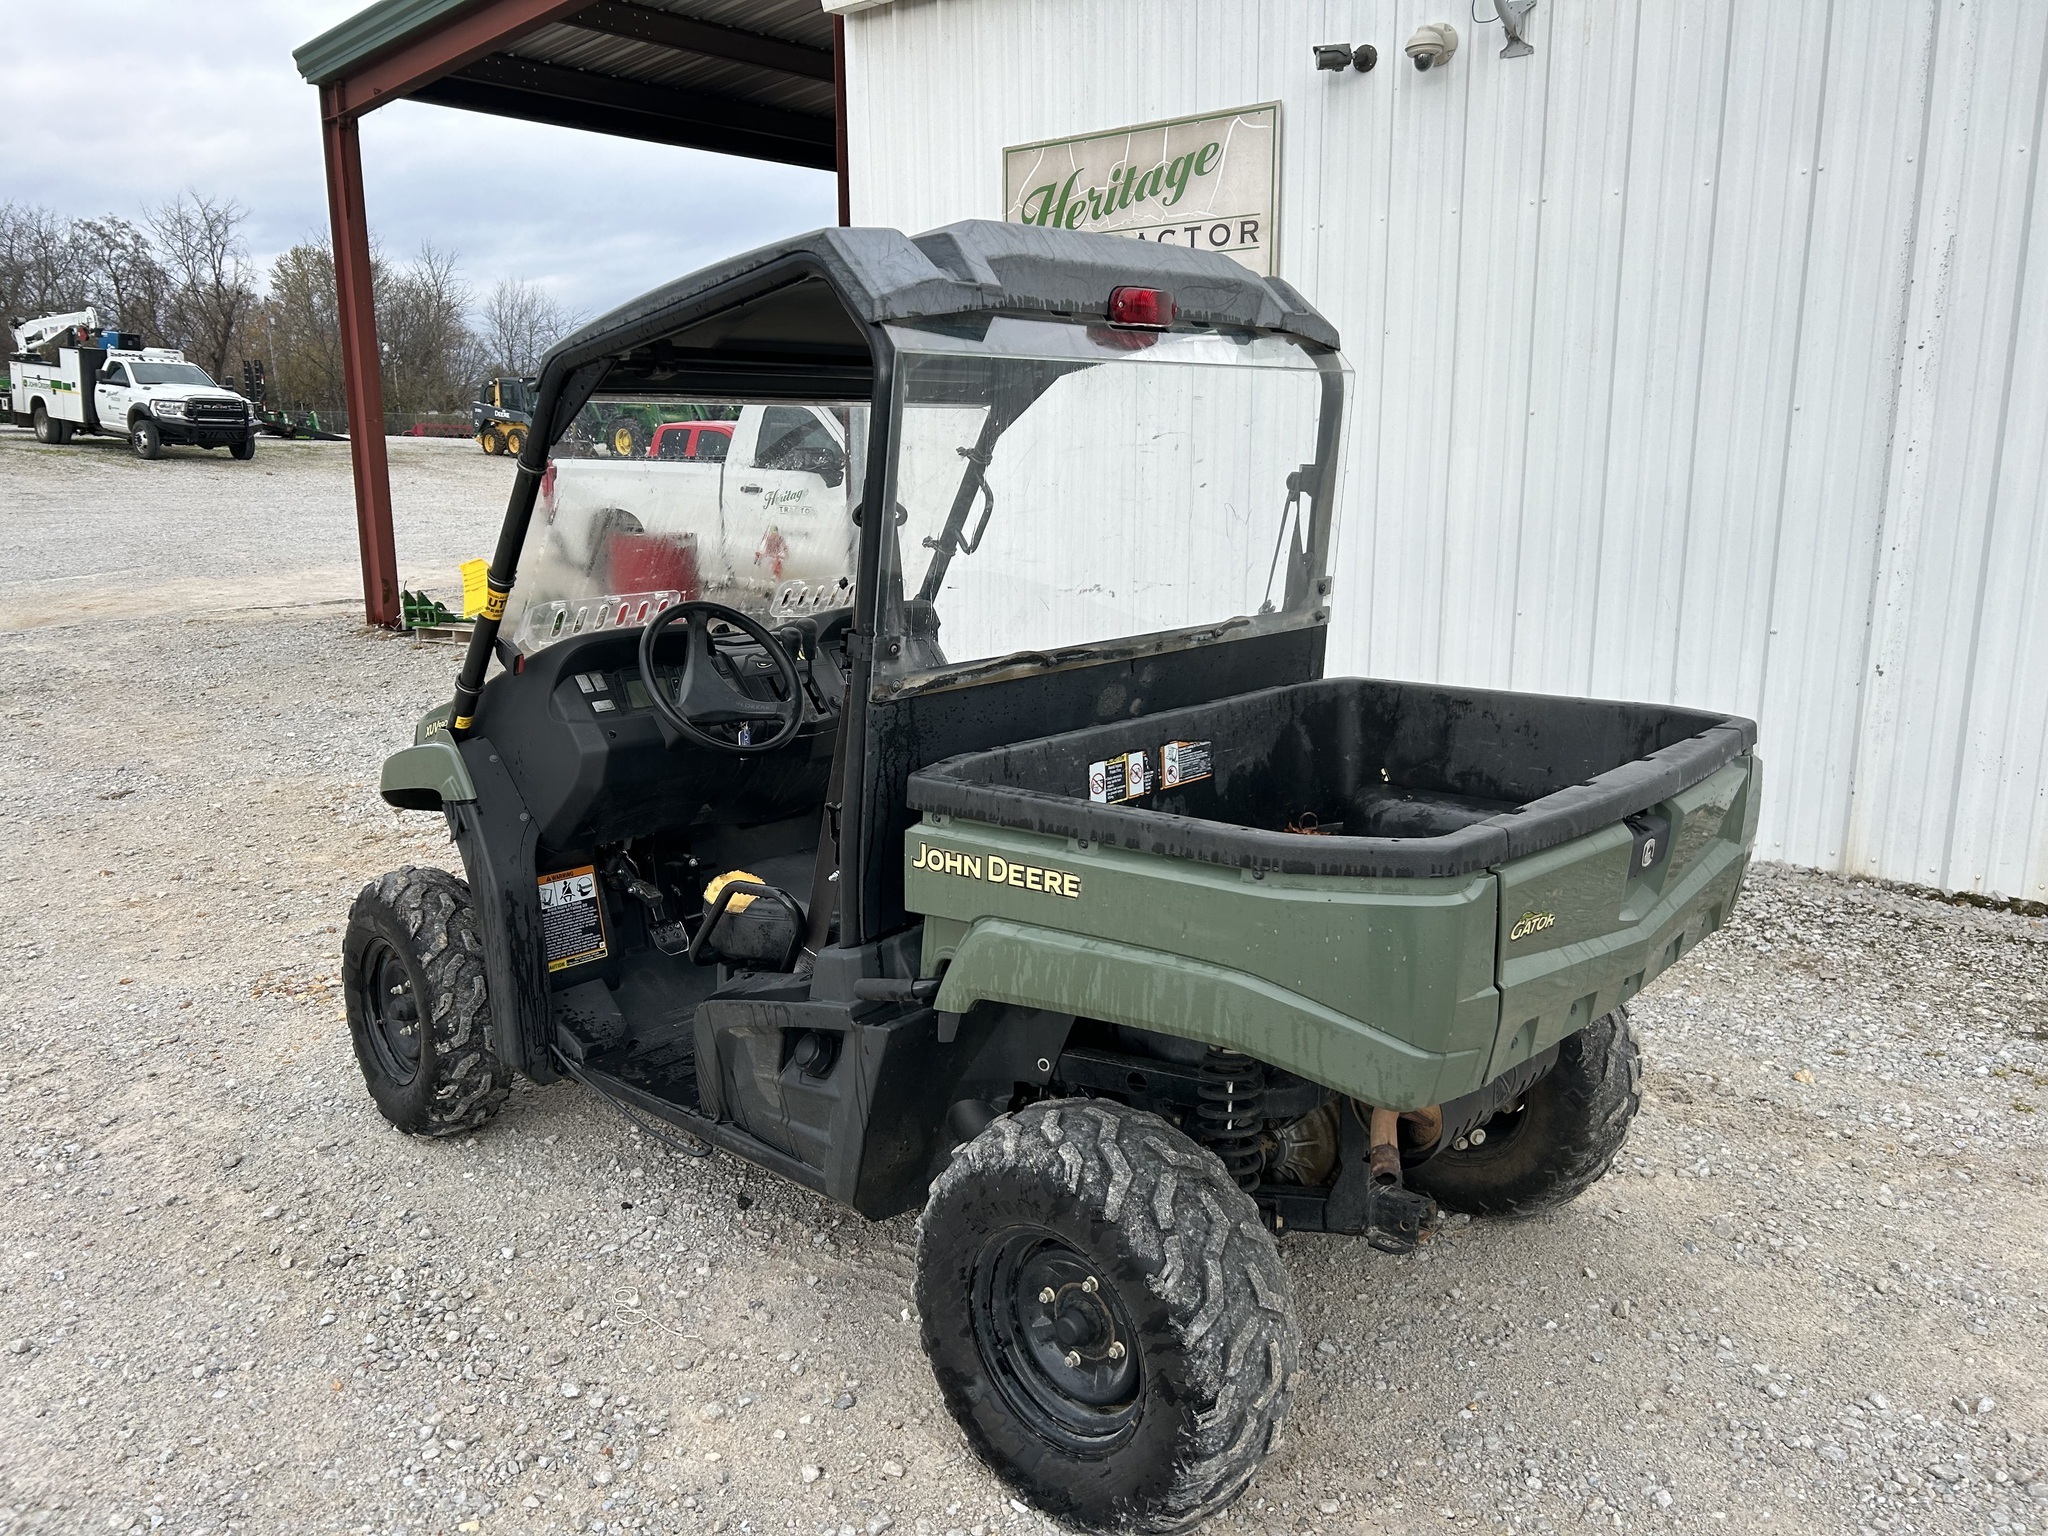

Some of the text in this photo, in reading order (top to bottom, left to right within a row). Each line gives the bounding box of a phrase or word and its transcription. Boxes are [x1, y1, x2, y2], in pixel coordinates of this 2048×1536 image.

[1021, 141, 1224, 230] Heritage
[494, 410, 510, 418] DEERE
[551, 871, 574, 881] WARNING
[912, 842, 1081, 899] JOHN DEERE
[1510, 914, 1556, 941] GATOR
